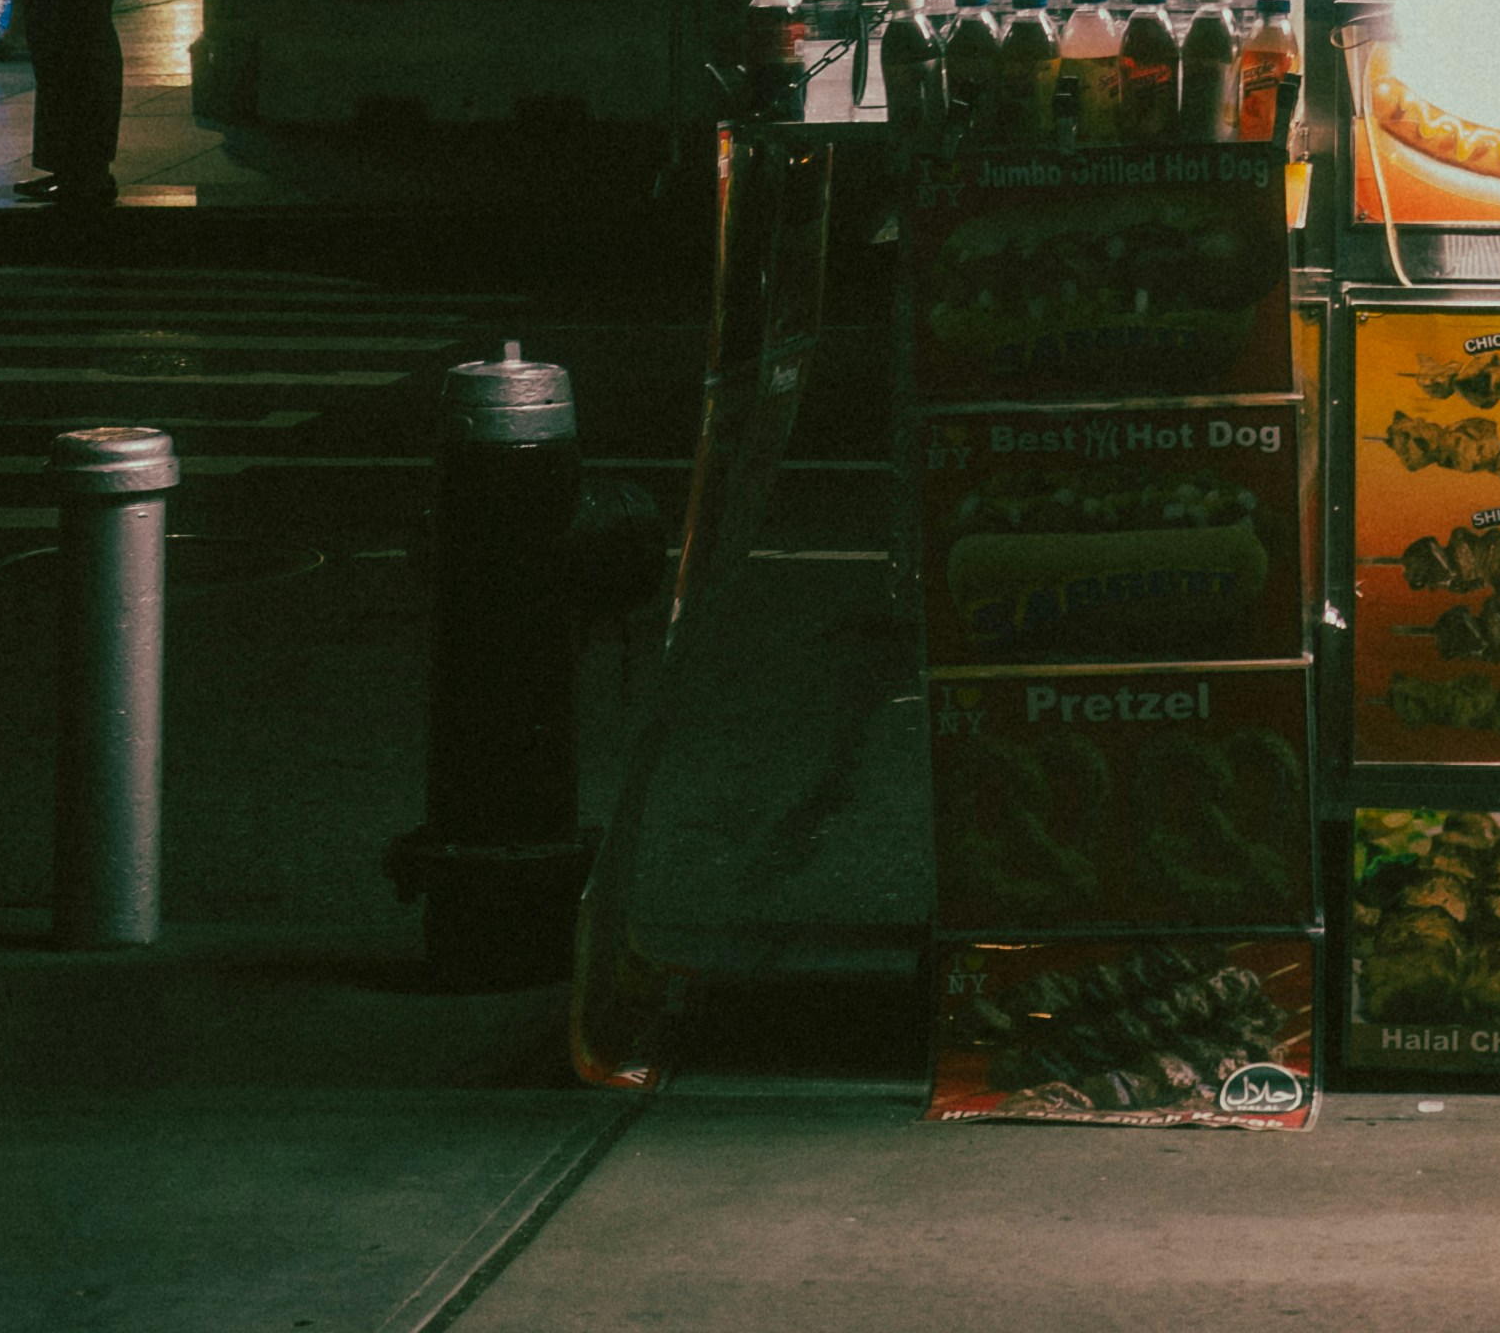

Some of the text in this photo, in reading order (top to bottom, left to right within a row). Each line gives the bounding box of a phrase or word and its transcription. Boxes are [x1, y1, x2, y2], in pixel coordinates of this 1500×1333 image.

[977, 159, 1062, 189] Jumbo
[1164, 154, 1209, 182] Hot
[1219, 153, 1269, 188] Dog
[990, 420, 1282, 453] Best Hot Dog
[1026, 682, 1210, 723] Pretzel
[938, 710, 987, 734] NY
[948, 974, 987, 994] NY
[1380, 1026, 1459, 1053] Halal
[1226, 1075, 1297, 1106] حلال
